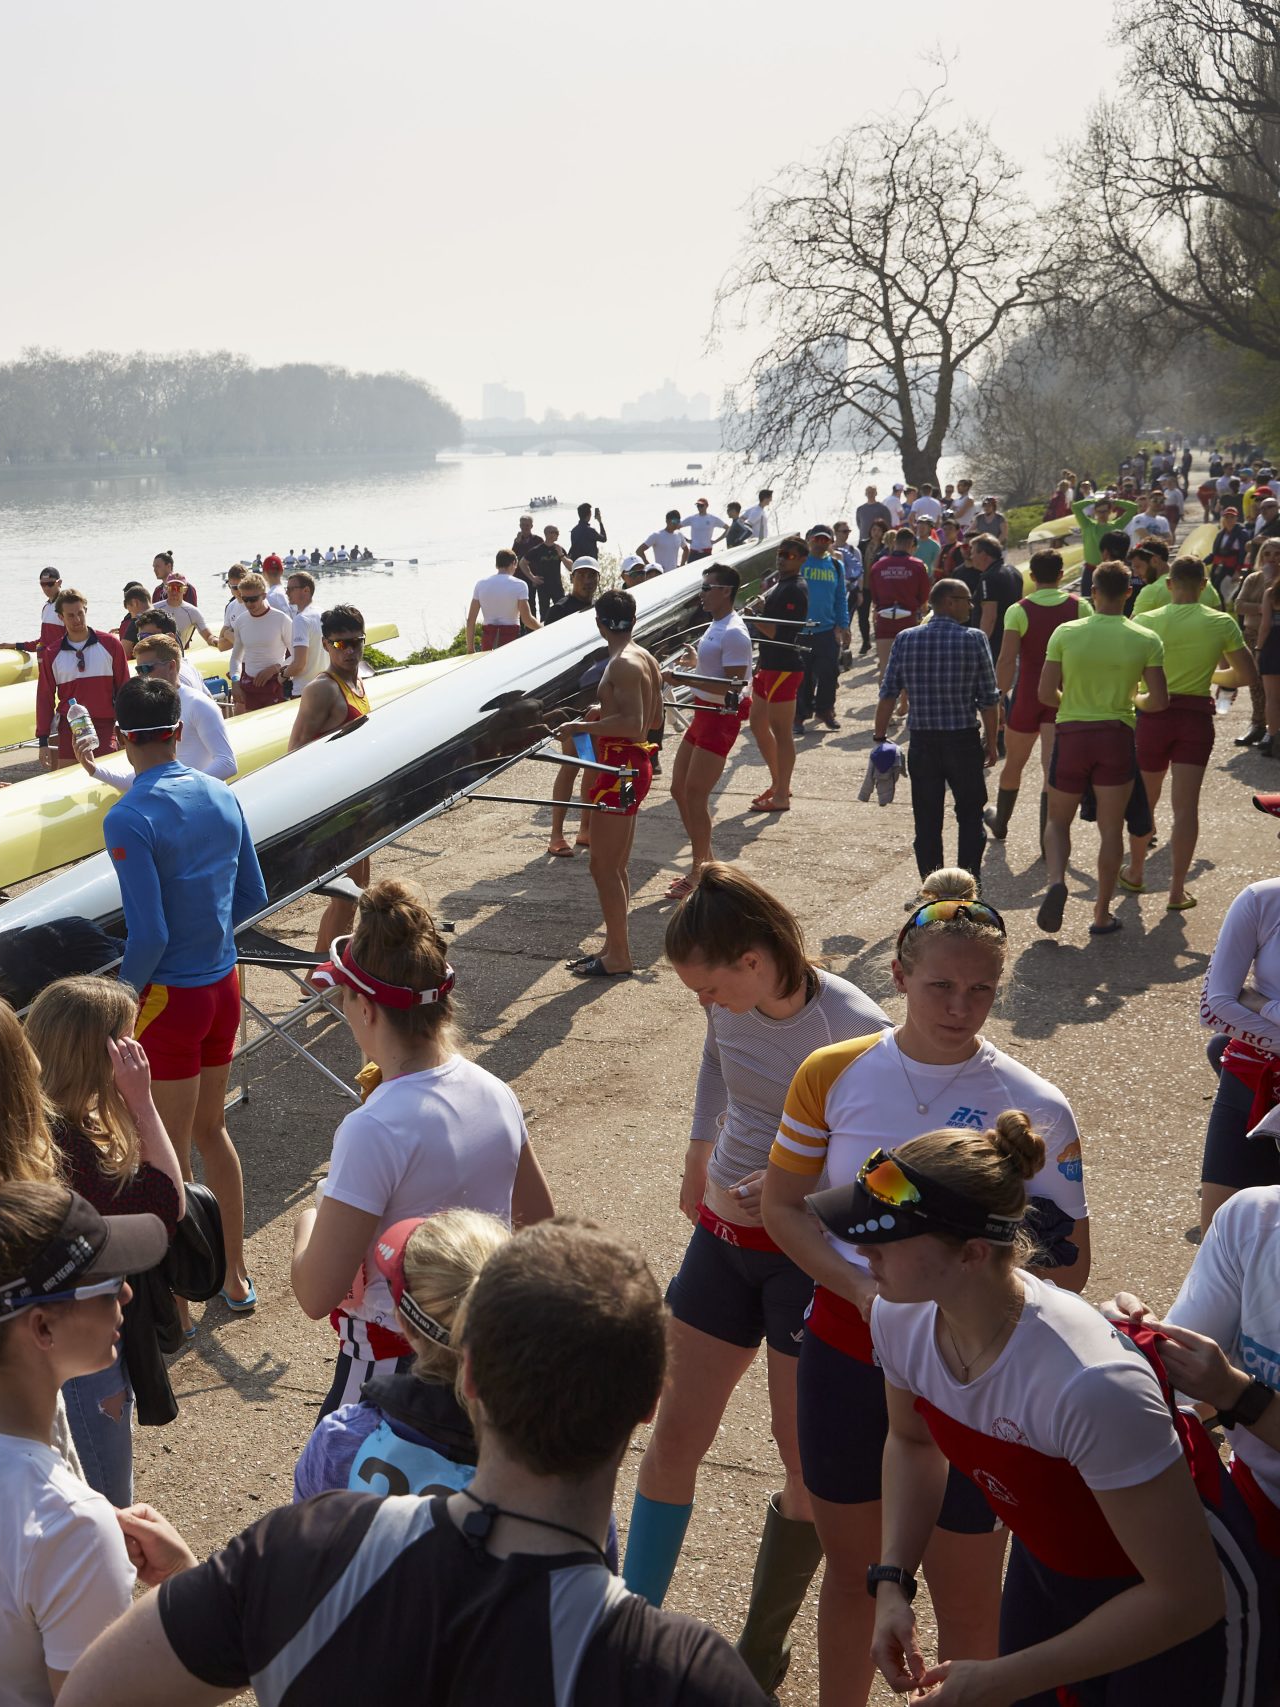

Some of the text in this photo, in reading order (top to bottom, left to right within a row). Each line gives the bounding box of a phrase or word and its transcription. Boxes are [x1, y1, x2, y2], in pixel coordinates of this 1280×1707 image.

[804, 567, 835, 582] CHINA
[1241, 1030, 1273, 1049] RC
[42, 1276, 58, 1293] AIR
[55, 1260, 77, 1282] HEAD
